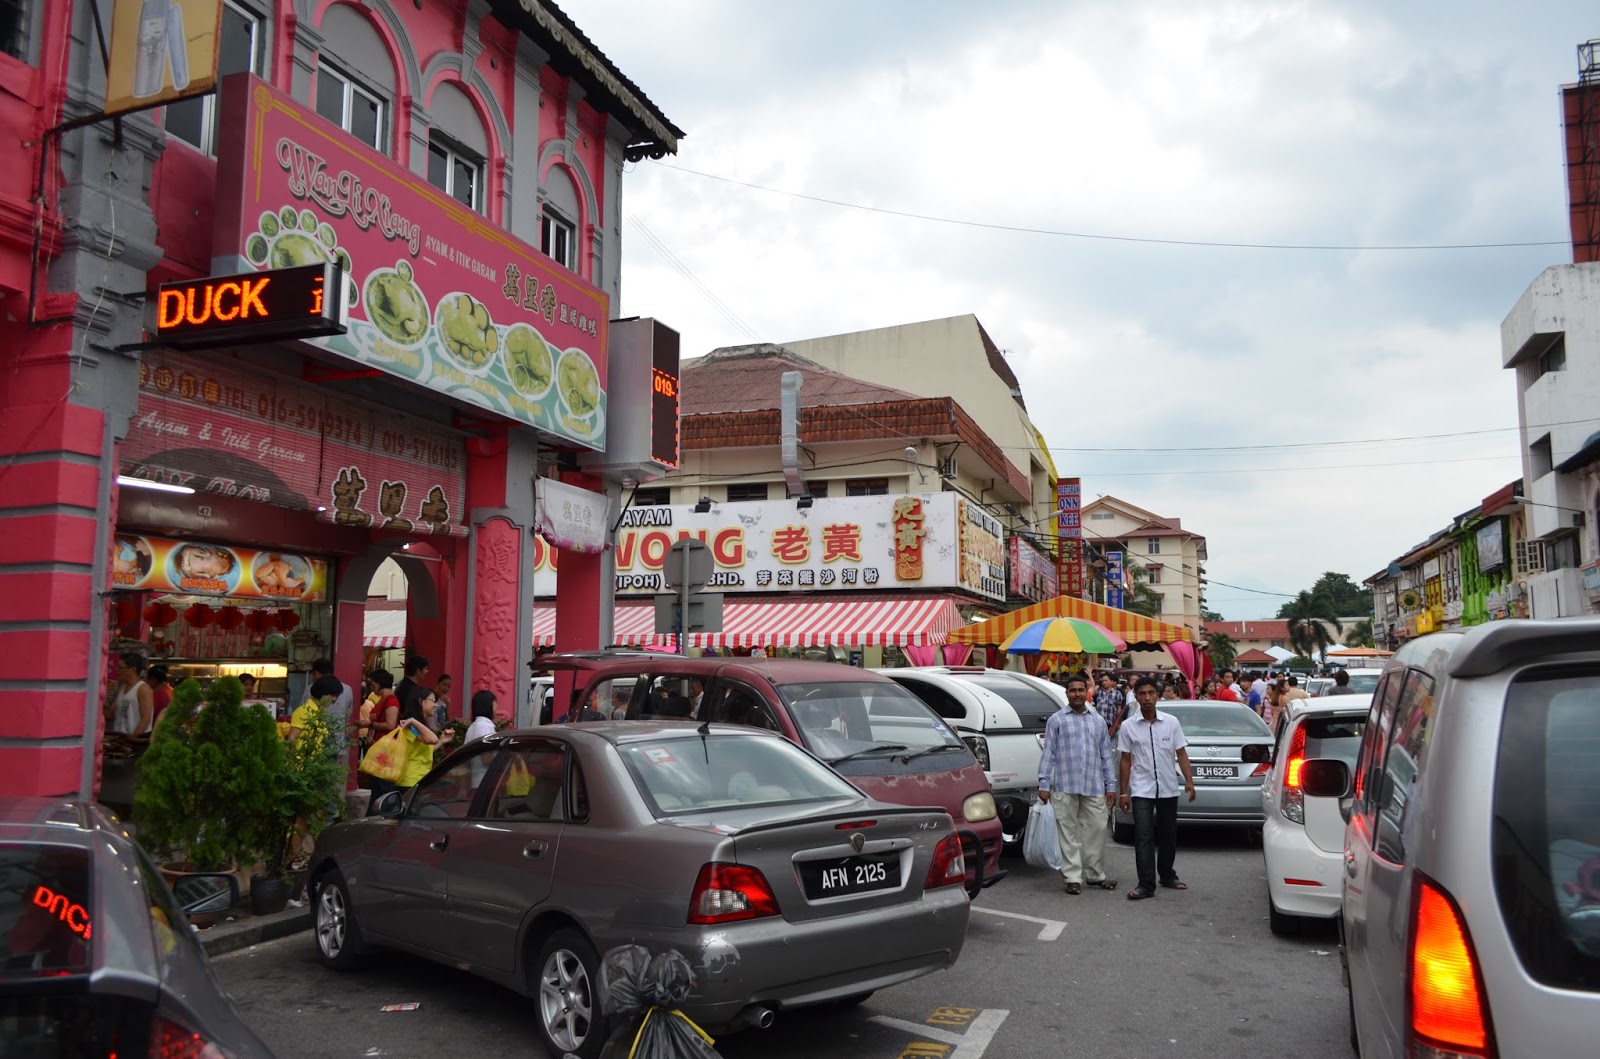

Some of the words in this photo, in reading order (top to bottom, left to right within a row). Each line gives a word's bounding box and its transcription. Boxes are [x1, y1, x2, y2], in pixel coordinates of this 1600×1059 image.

[425, 235, 448, 258] AYAM
[449, 247, 455, 262] &
[455, 250, 471, 269] ITIK
[471, 258, 497, 283] GARAM
[157, 277, 271, 329] DUCK
[502, 262, 557, 326] 萬里香
[654, 375, 676, 397] 019-
[138, 410, 190, 436] Ayam
[257, 437, 307, 462] Garam
[1059, 498, 1079, 511] ONN
[621, 508, 672, 527] AYAM
[1060, 513, 1079, 526] KEE
[615, 574, 661, 590] (IPOH)
[1196, 767, 1212, 776] BLH
[1213, 767, 1233, 776] 6226
[822, 867, 849, 889] AFN
[855, 862, 886, 884] 2125
